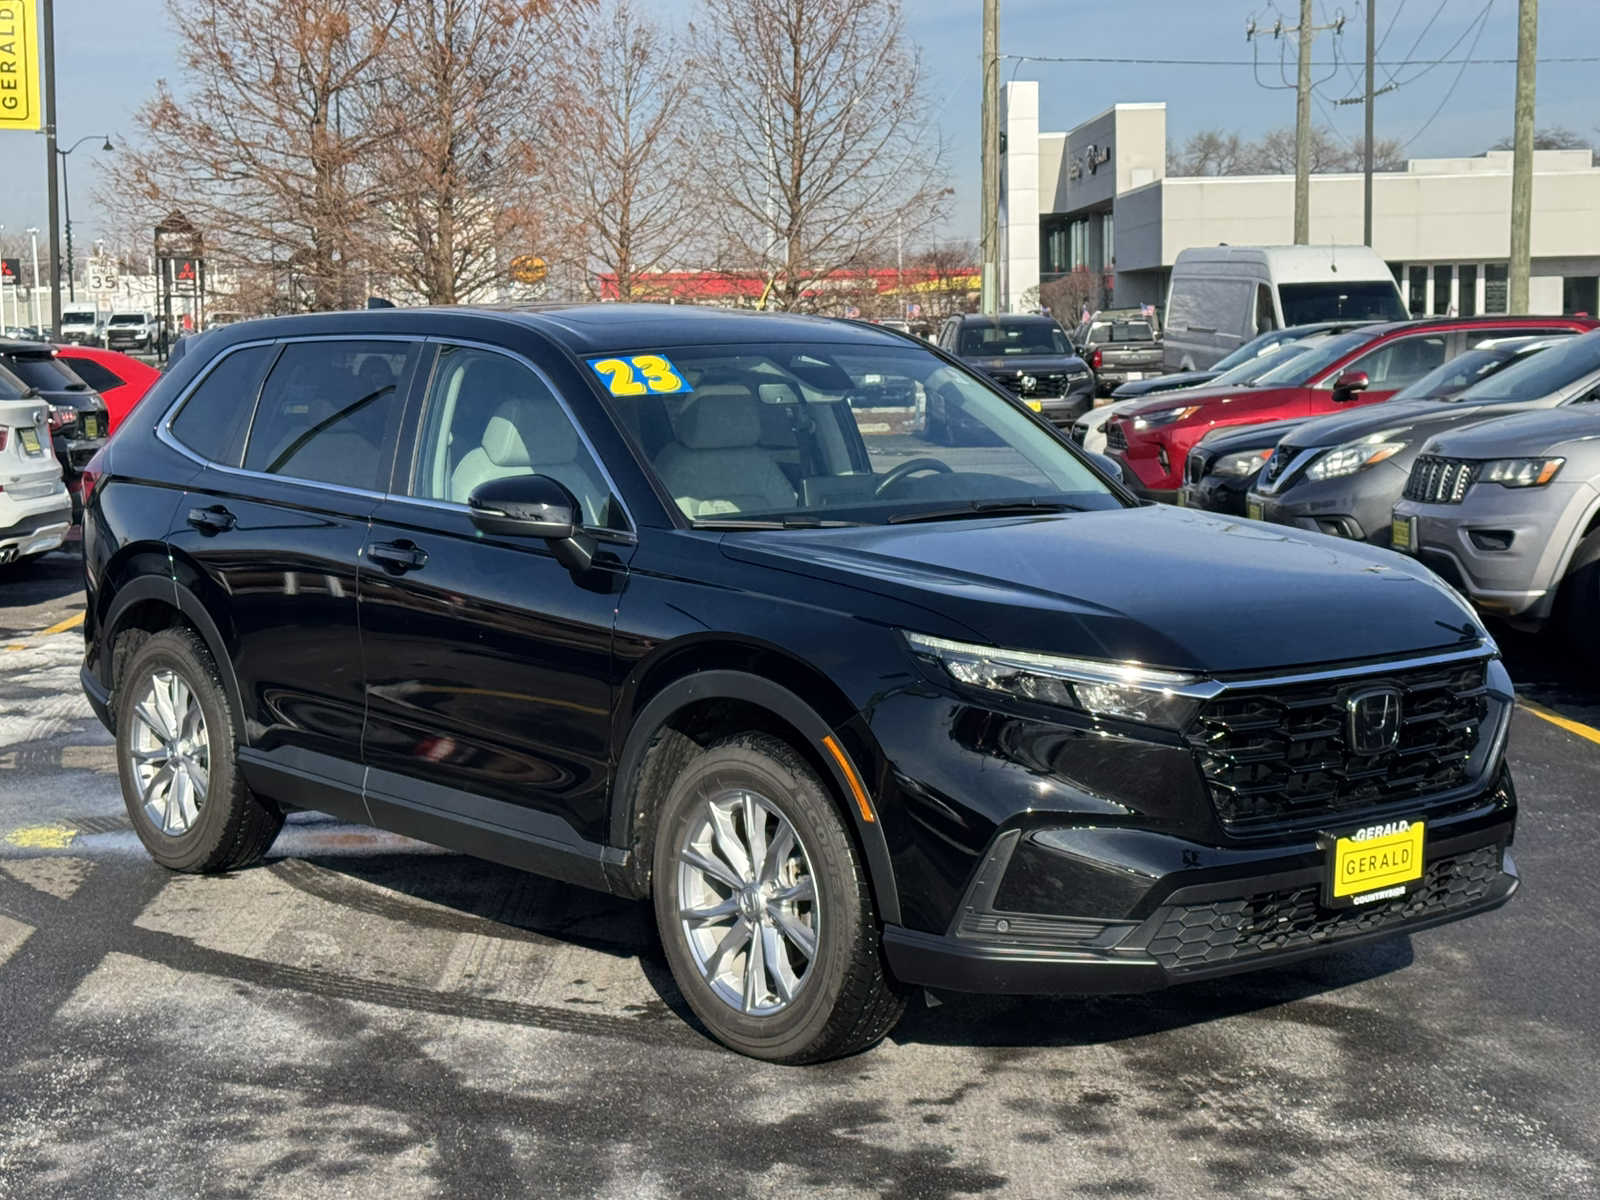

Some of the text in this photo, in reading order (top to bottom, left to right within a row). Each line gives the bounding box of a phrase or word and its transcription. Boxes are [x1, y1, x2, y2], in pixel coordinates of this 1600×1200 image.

[0, 8, 19, 110] GERALD
[91, 275, 117, 289] 35
[594, 355, 683, 395] 23
[1355, 820, 1408, 841] GERALD
[1346, 848, 1409, 875] GERALD
[1353, 886, 1406, 905] COUNTRYSIDE
